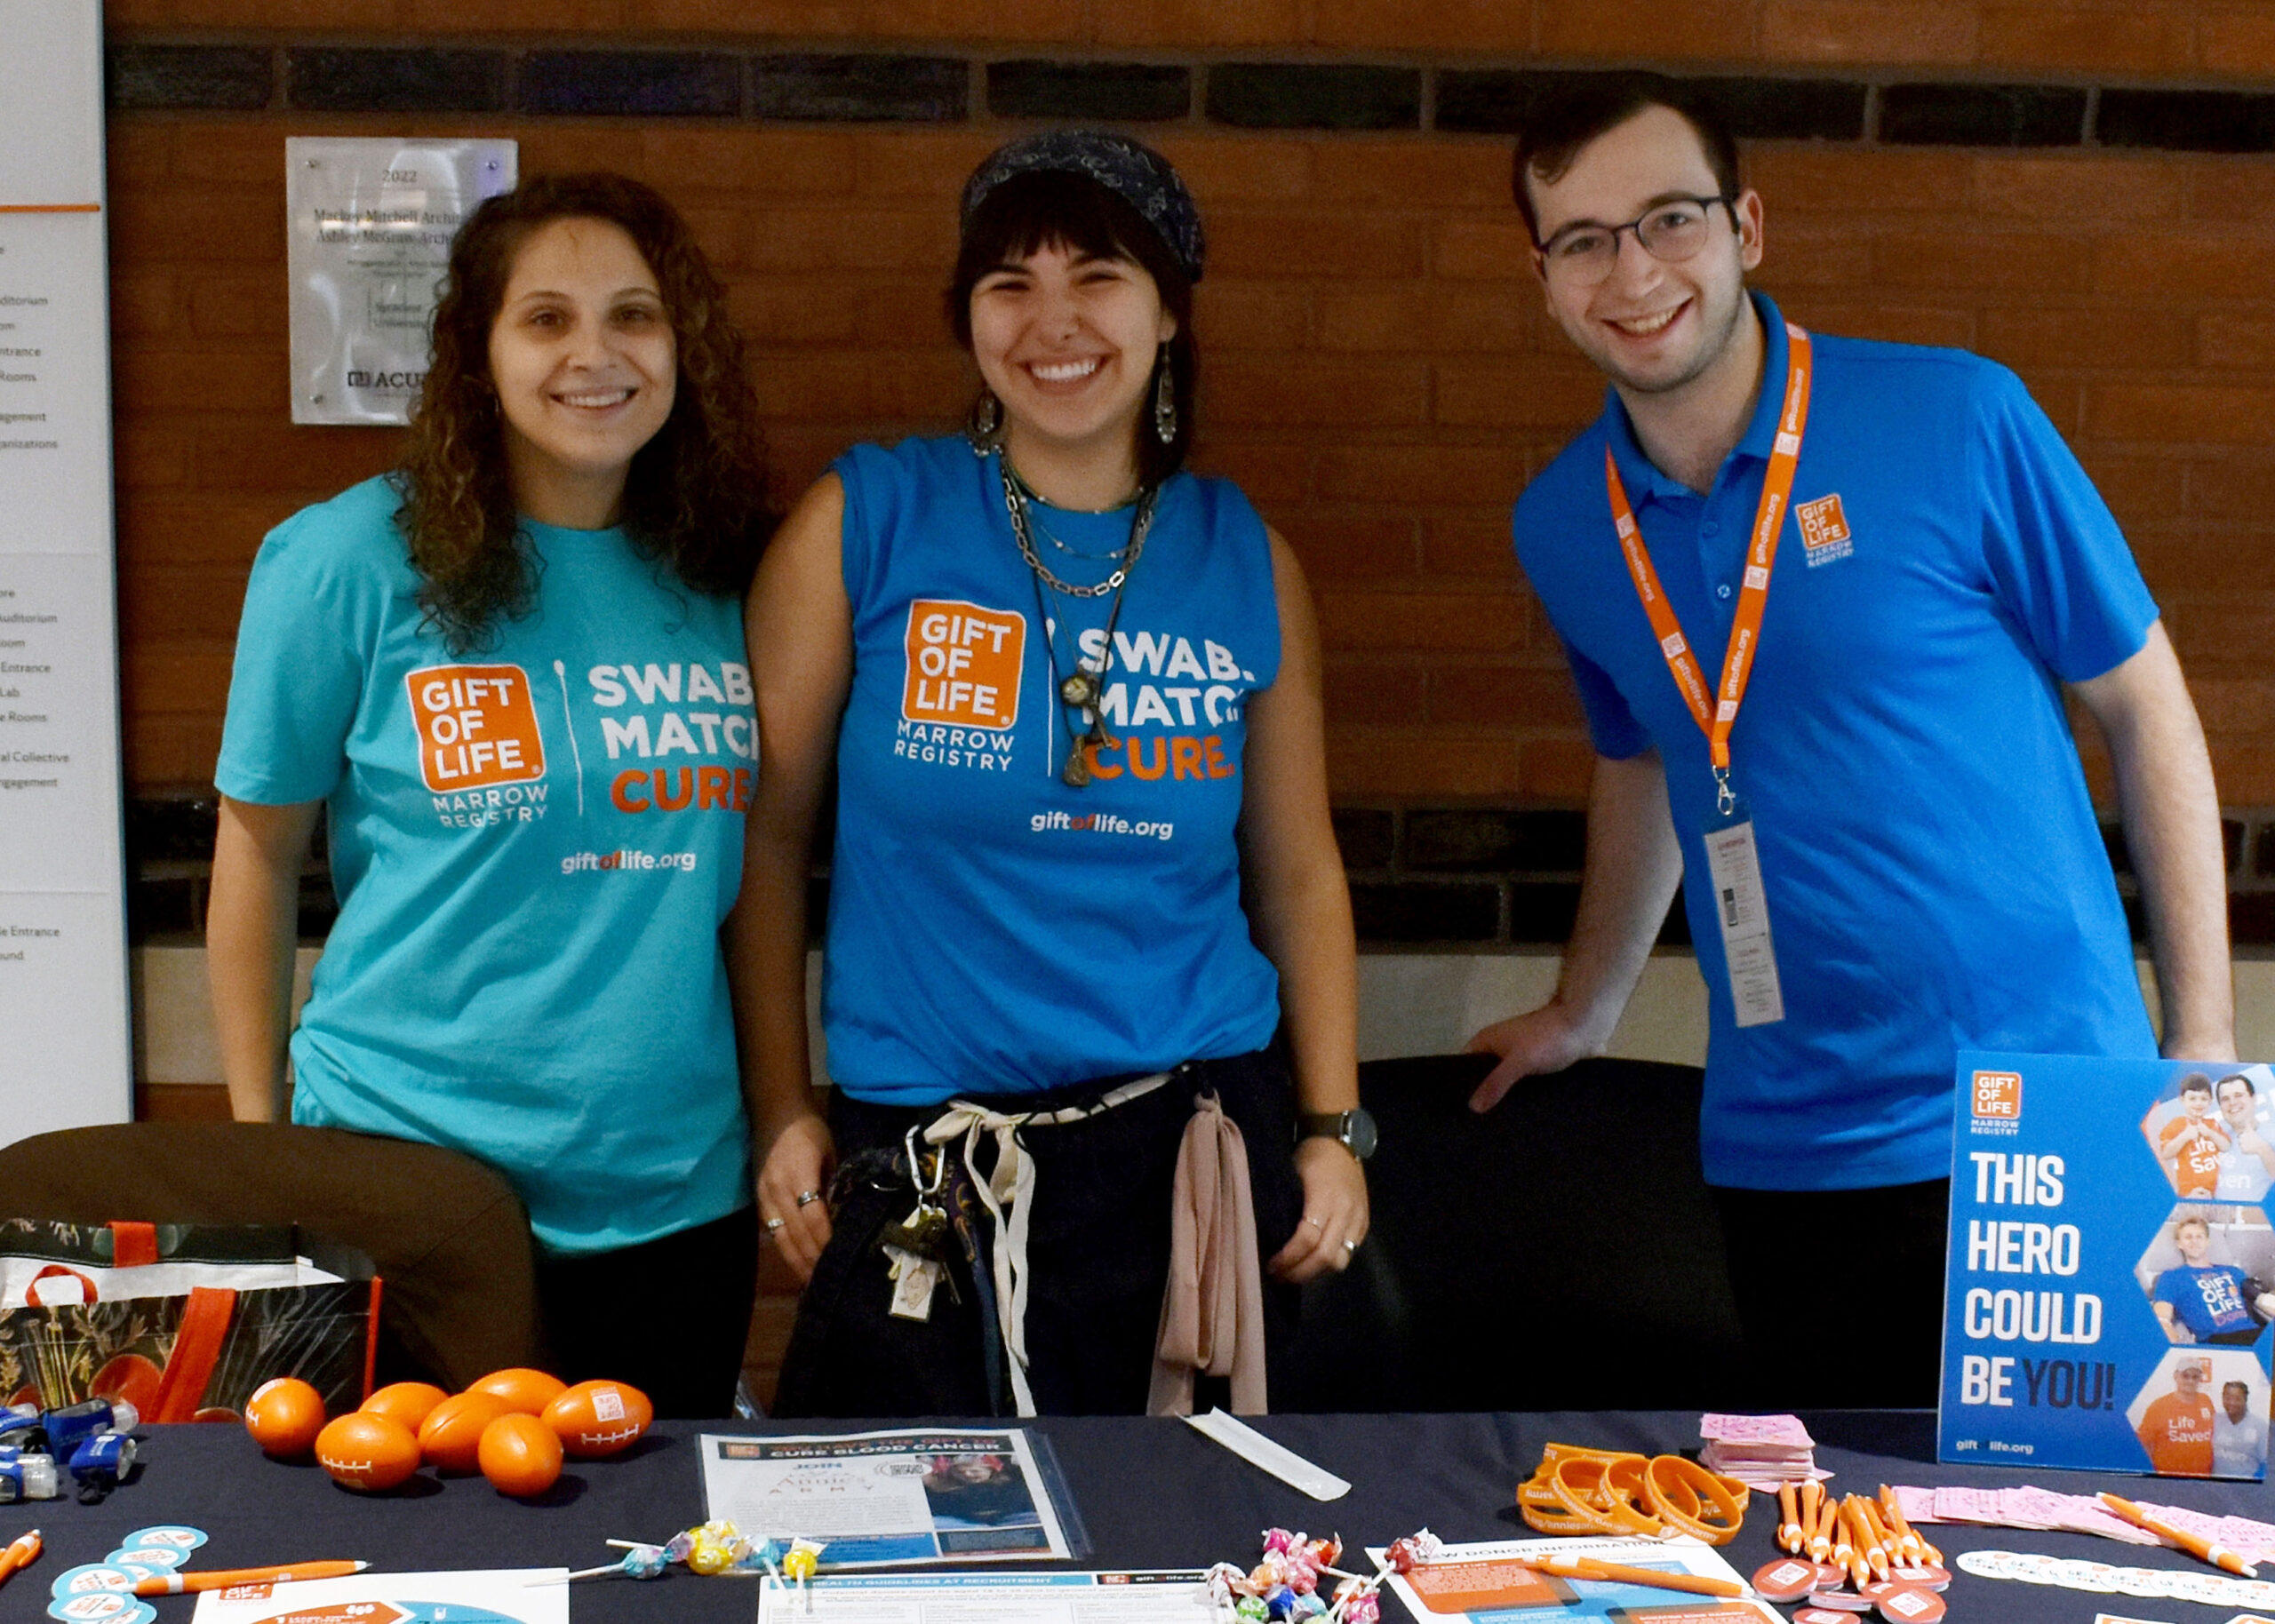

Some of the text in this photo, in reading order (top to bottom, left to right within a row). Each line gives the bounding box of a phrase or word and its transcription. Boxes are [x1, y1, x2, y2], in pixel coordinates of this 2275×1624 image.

[382, 169, 419, 183] 2022
[374, 370, 425, 388] ACU
[1801, 498, 1836, 521] GIFT
[1807, 524, 1843, 546] LIFE
[921, 613, 1012, 654] GIFT
[919, 646, 974, 679] OF
[421, 677, 515, 713] GIFT
[588, 661, 755, 707] SWAB
[915, 679, 999, 717] LIFE
[8, 711, 47, 722] Rooms
[430, 709, 484, 745] OF
[898, 720, 1015, 753] MARROW
[12, 751, 70, 762] Collective
[434, 739, 525, 780] LIFE
[894, 739, 1013, 773] REGISTRY
[432, 784, 549, 813] MARROW
[610, 765, 754, 815] CURE
[1031, 810, 1174, 841] giftoflife.org
[561, 849, 697, 875] giftoflife.org
[11, 925, 61, 937] Entrance
[1977, 1088, 2002, 1102] OF
[1978, 1076, 2016, 1090] GIFT
[1977, 1101, 2013, 1115] LIFE
[1969, 1151, 2065, 1207] THIS
[1967, 1219, 2081, 1277] HERO
[2197, 1274, 2235, 1291] GIFT
[1963, 1287, 2103, 1345] COULD
[1960, 1355, 2117, 1413] BE YOU!
[2168, 1415, 2196, 1429] Life
[834, 1445, 907, 1455] BLOOD
[913, 1443, 1001, 1452] CANCER
[1465, 1548, 1532, 1556] DONOR
